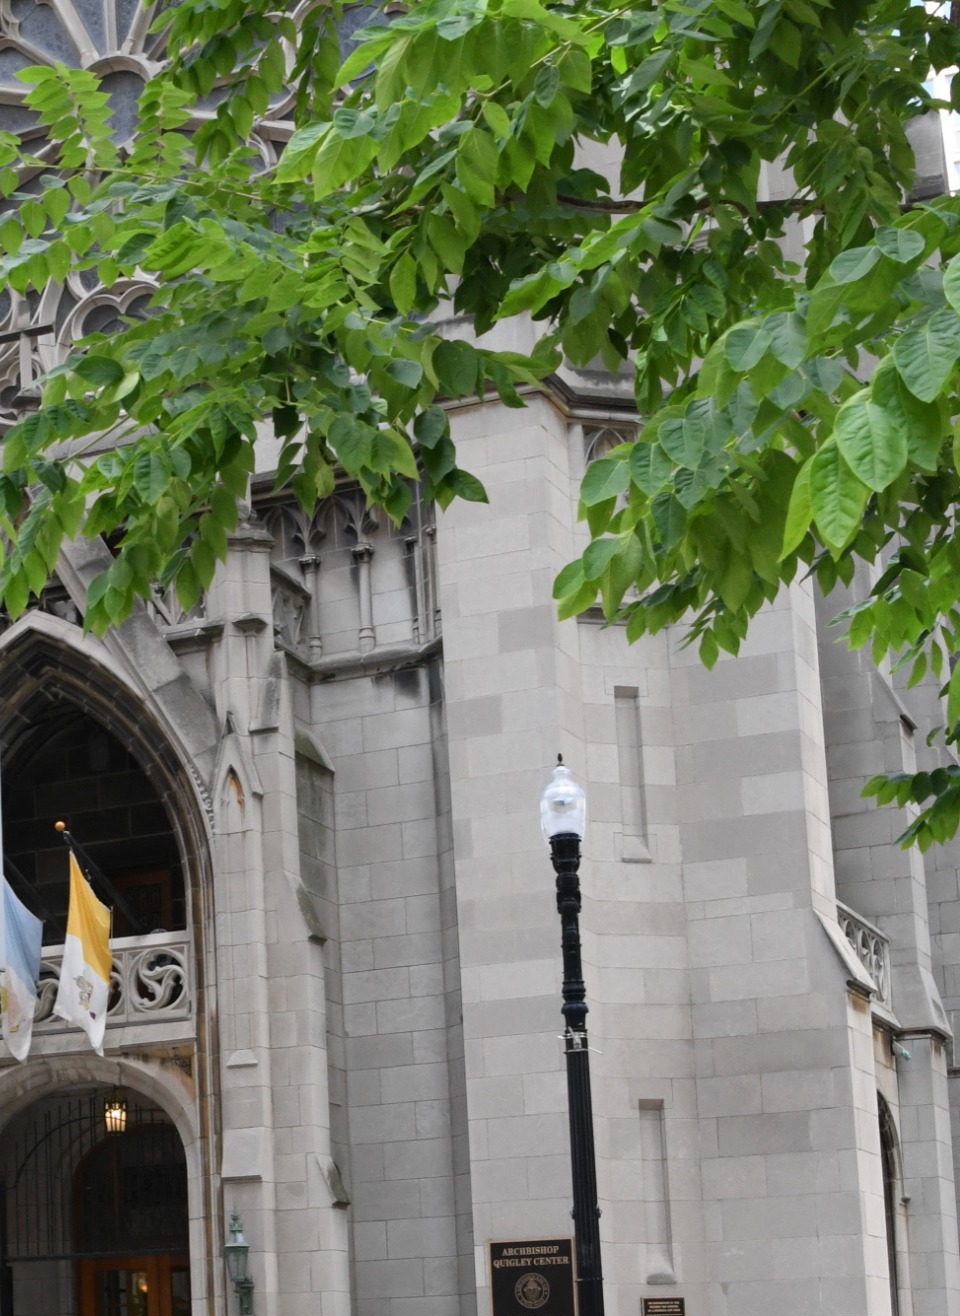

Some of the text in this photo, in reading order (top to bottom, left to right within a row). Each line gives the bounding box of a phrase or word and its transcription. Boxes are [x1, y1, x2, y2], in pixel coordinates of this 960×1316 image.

[502, 1245, 559, 1256] ARCHBISHOP
[493, 1256, 570, 1269] QUIGLEY CENTER
